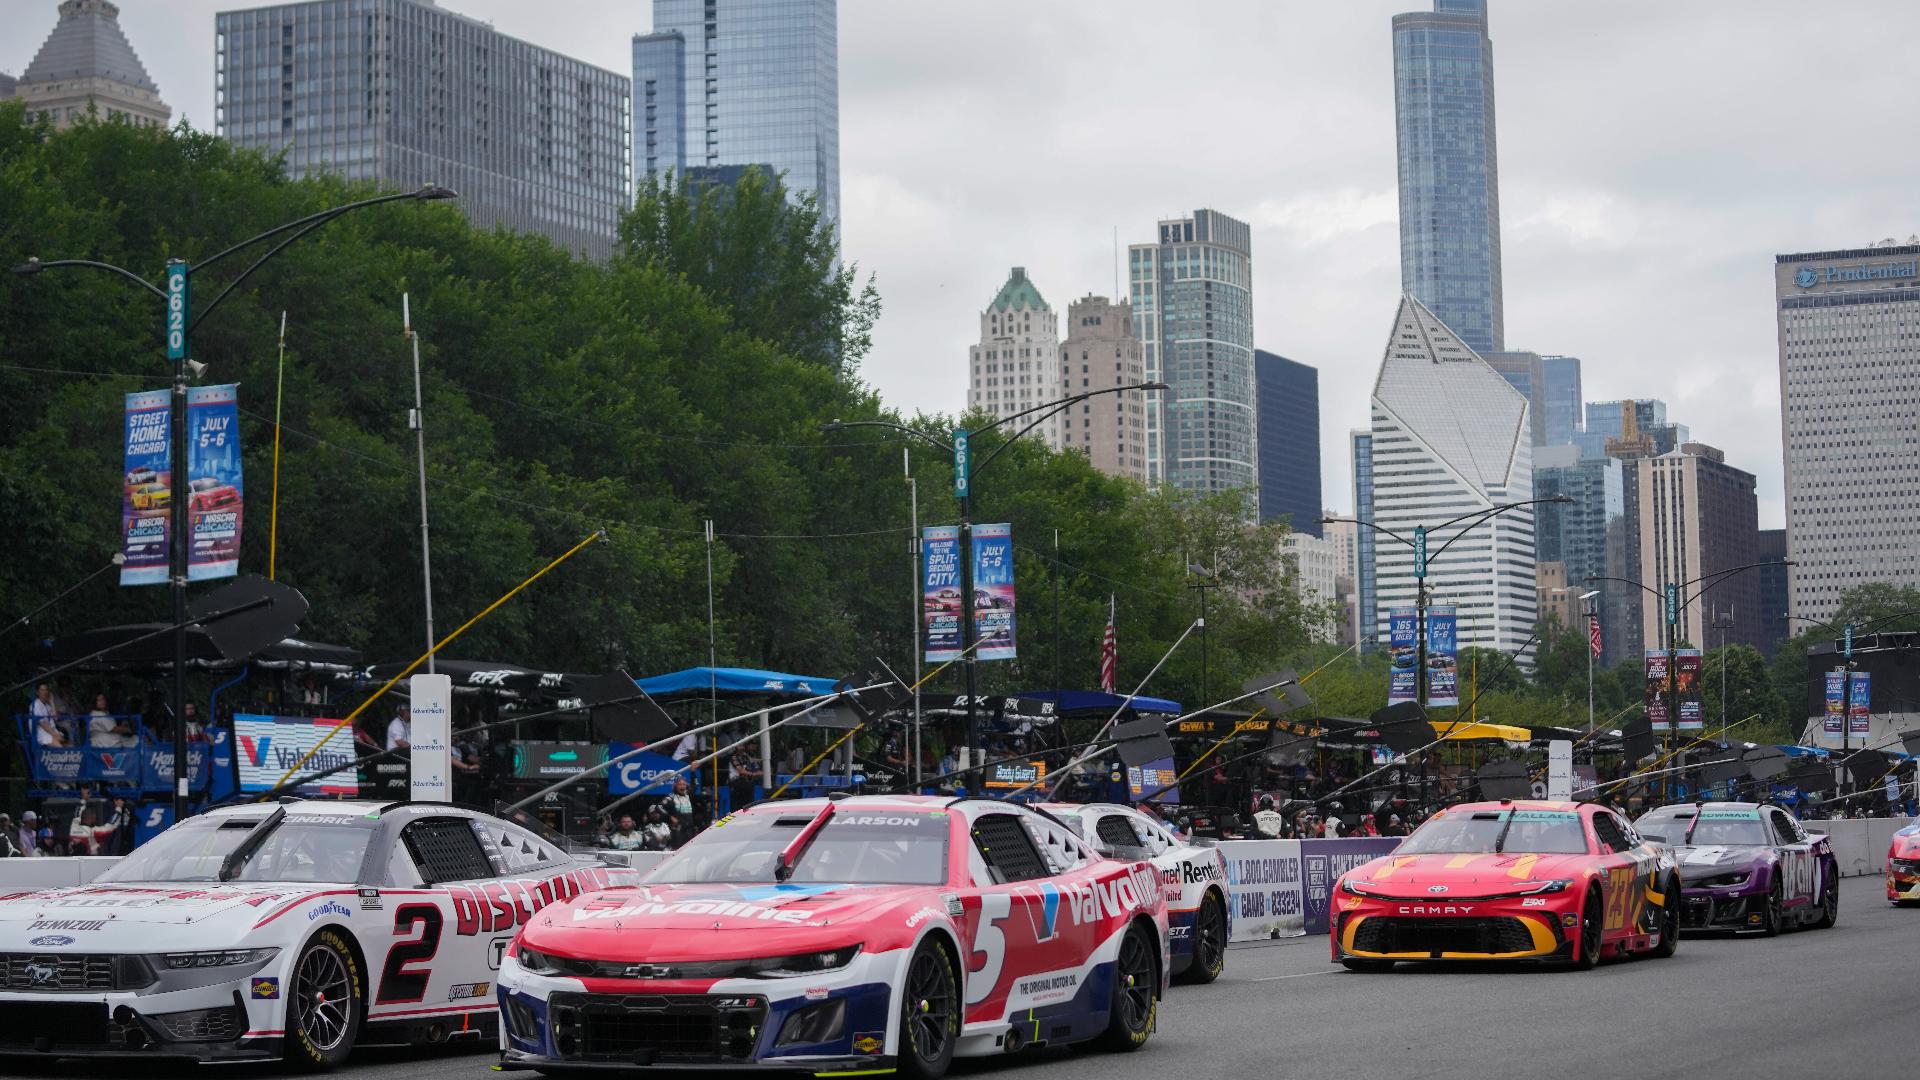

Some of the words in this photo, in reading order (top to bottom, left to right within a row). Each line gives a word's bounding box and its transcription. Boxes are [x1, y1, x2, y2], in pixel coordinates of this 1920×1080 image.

[1826, 260, 1917, 283] Prudential
[169, 273, 184, 349] C620
[129, 410, 169, 427] STREET
[201, 417, 230, 432] JULY
[128, 423, 168, 443] HOME
[200, 432, 227, 448] 5-6
[127, 441, 166, 456] CHICAGO
[955, 437, 966, 490] C610
[205, 513, 237, 524] NASCAR
[128, 525, 164, 536] CHICAGO
[194, 522, 235, 532] CHICAGO
[982, 546, 1004, 556] JULY
[1415, 533, 1424, 573] C600
[929, 554, 957, 564] SPLIT-
[982, 557, 1002, 567] 5-6
[927, 572, 956, 586] CITY
[953, 695, 988, 706] RK
[214, 732, 226, 744] 5
[146, 808, 164, 828] 5
[829, 816, 920, 826] LARSON
[1238, 857, 1300, 885] 1.800.GAMBLER
[1271, 889, 1301, 917] 833234
[1399, 905, 1475, 914] CAMRY
[573, 900, 814, 924] Valvoline
[27, 920, 107, 931] PENNZOIL
[375, 902, 444, 1006] 2
[964, 893, 1012, 1005] 5
[252, 984, 278, 993] SUNOCO
[1020, 983, 1029, 995] THE
[1029, 978, 1051, 993] ORIGINAL
[1051, 976, 1069, 990] MOTOR
[1069, 974, 1077, 986] OIL
